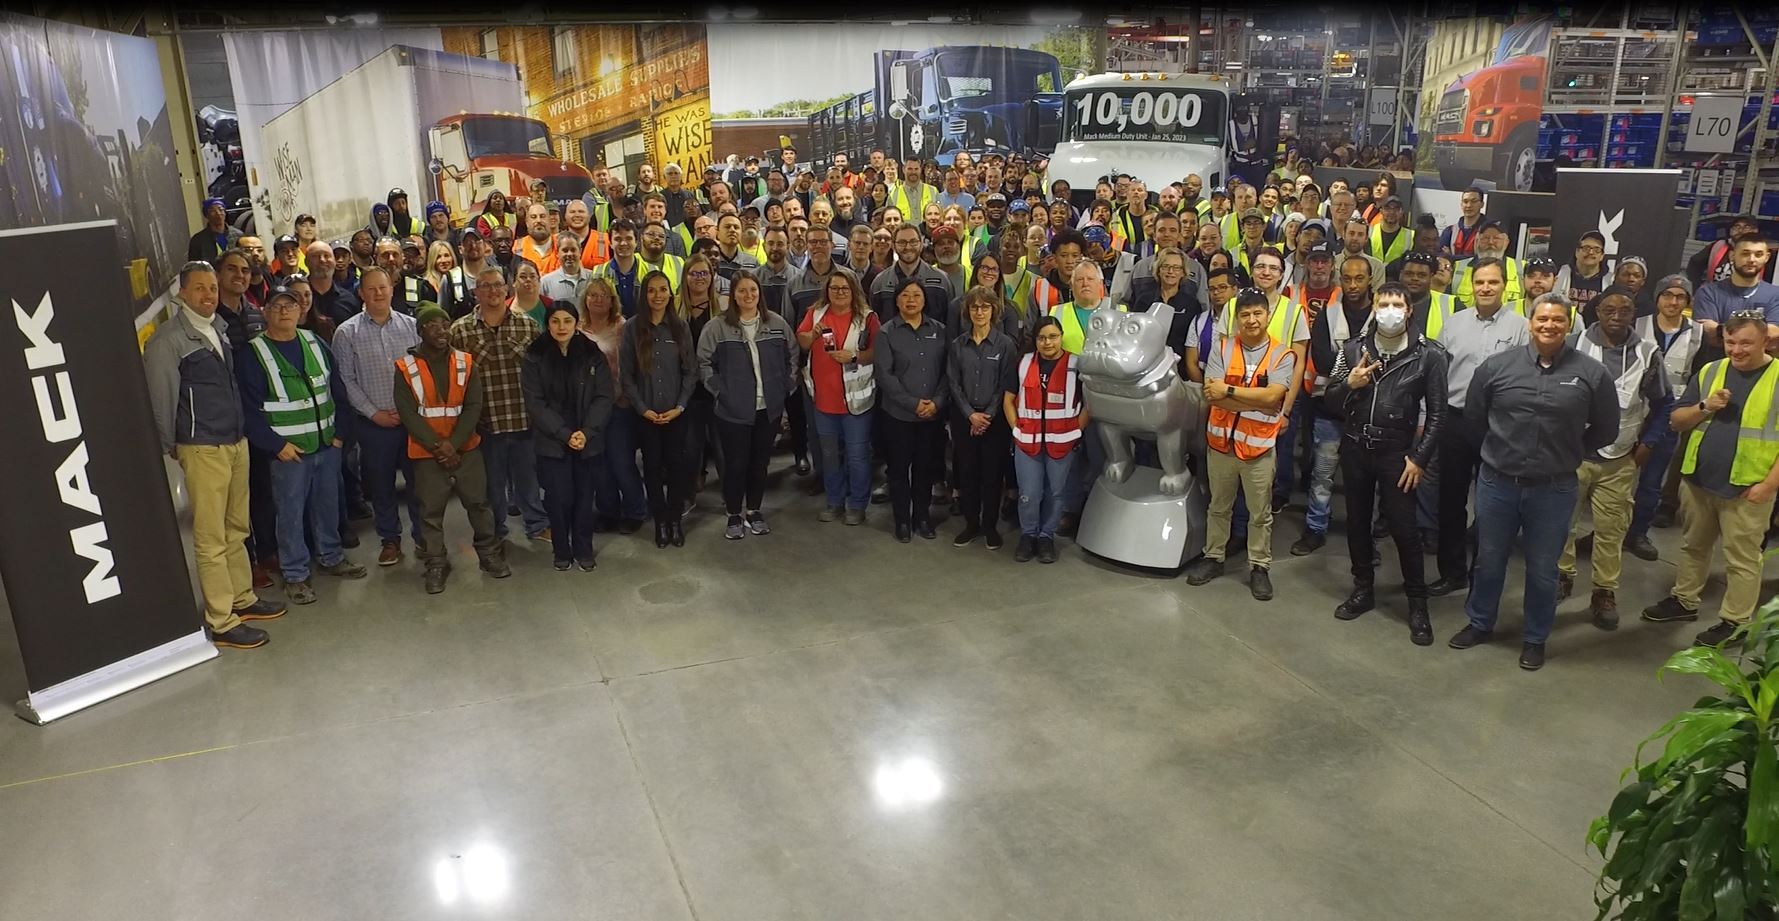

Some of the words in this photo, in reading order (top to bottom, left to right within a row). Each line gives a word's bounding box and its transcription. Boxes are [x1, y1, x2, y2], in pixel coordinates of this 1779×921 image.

[549, 78, 622, 118] WHOLESALE
[629, 46, 700, 86] SUPPLIES
[655, 117, 671, 131] HE
[675, 108, 705, 123] WAS
[1077, 92, 1202, 132] 10,000
[1372, 102, 1395, 115] L100
[663, 118, 712, 156] WISE
[1099, 132, 1121, 140] Medium
[1121, 132, 1135, 141] Duty
[1136, 132, 1148, 140] Unit
[1162, 133, 1171, 141] 25,
[1172, 134, 1187, 142] 2023
[1695, 117, 1731, 137] L70
[11, 290, 122, 604] MACK
